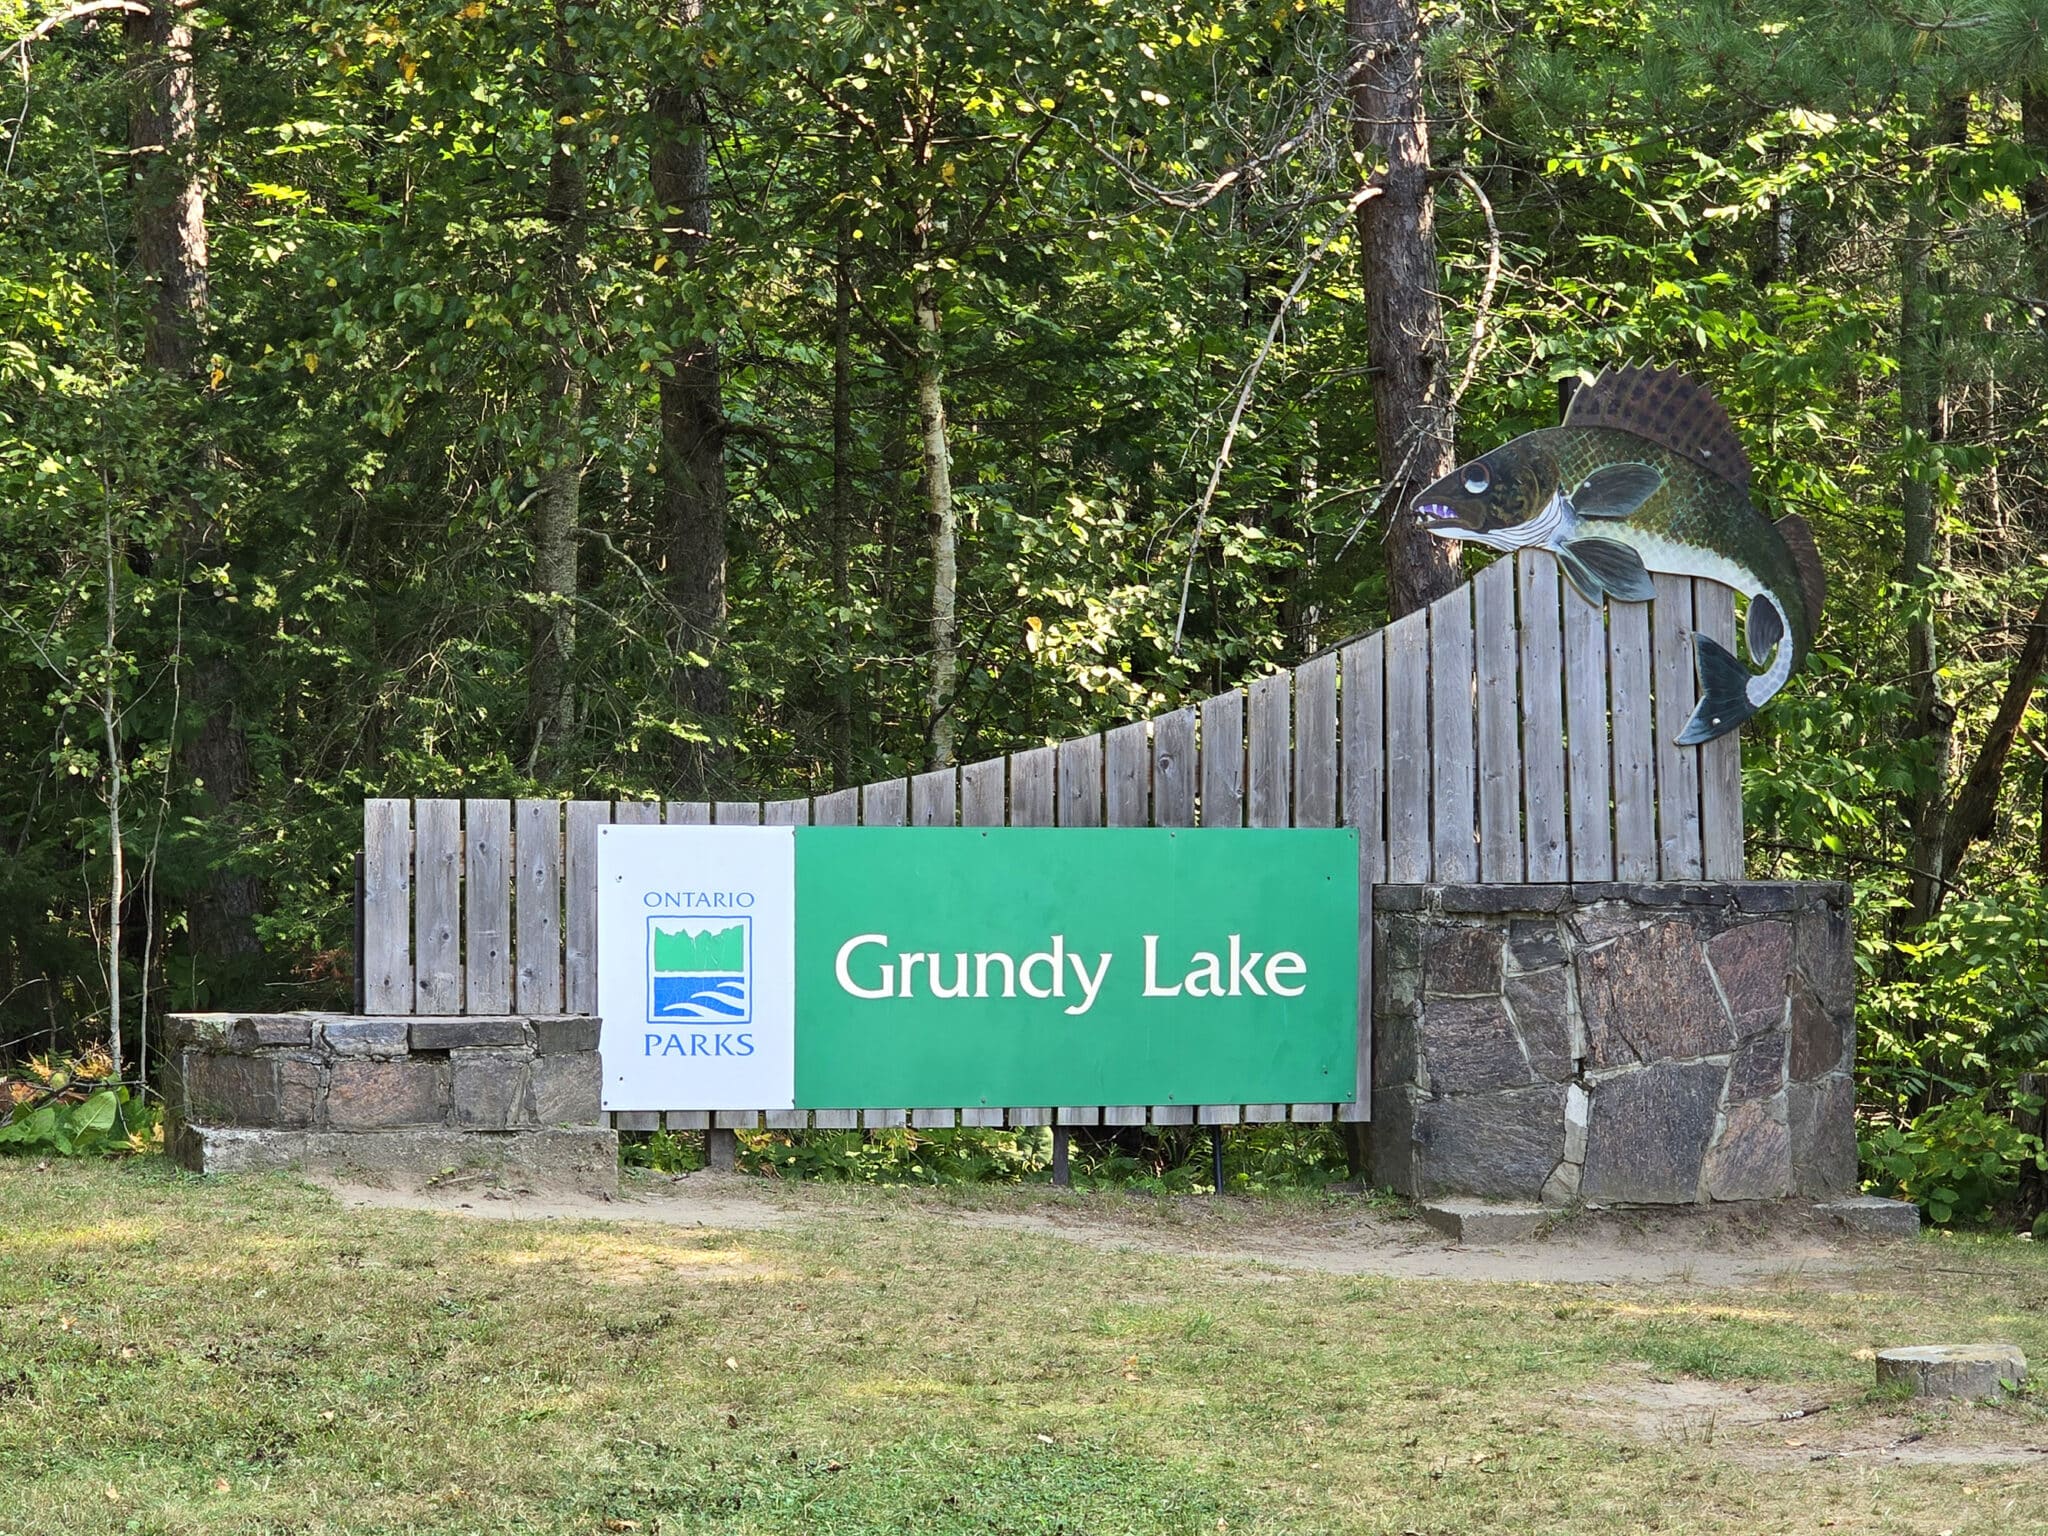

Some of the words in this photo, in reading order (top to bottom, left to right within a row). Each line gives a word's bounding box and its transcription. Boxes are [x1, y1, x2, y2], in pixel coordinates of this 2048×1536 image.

[643, 891, 755, 908] ONTARIO
[835, 933, 1113, 1016] Grundy
[1142, 933, 1307, 998] Lake
[644, 1033, 755, 1057] PARKS
